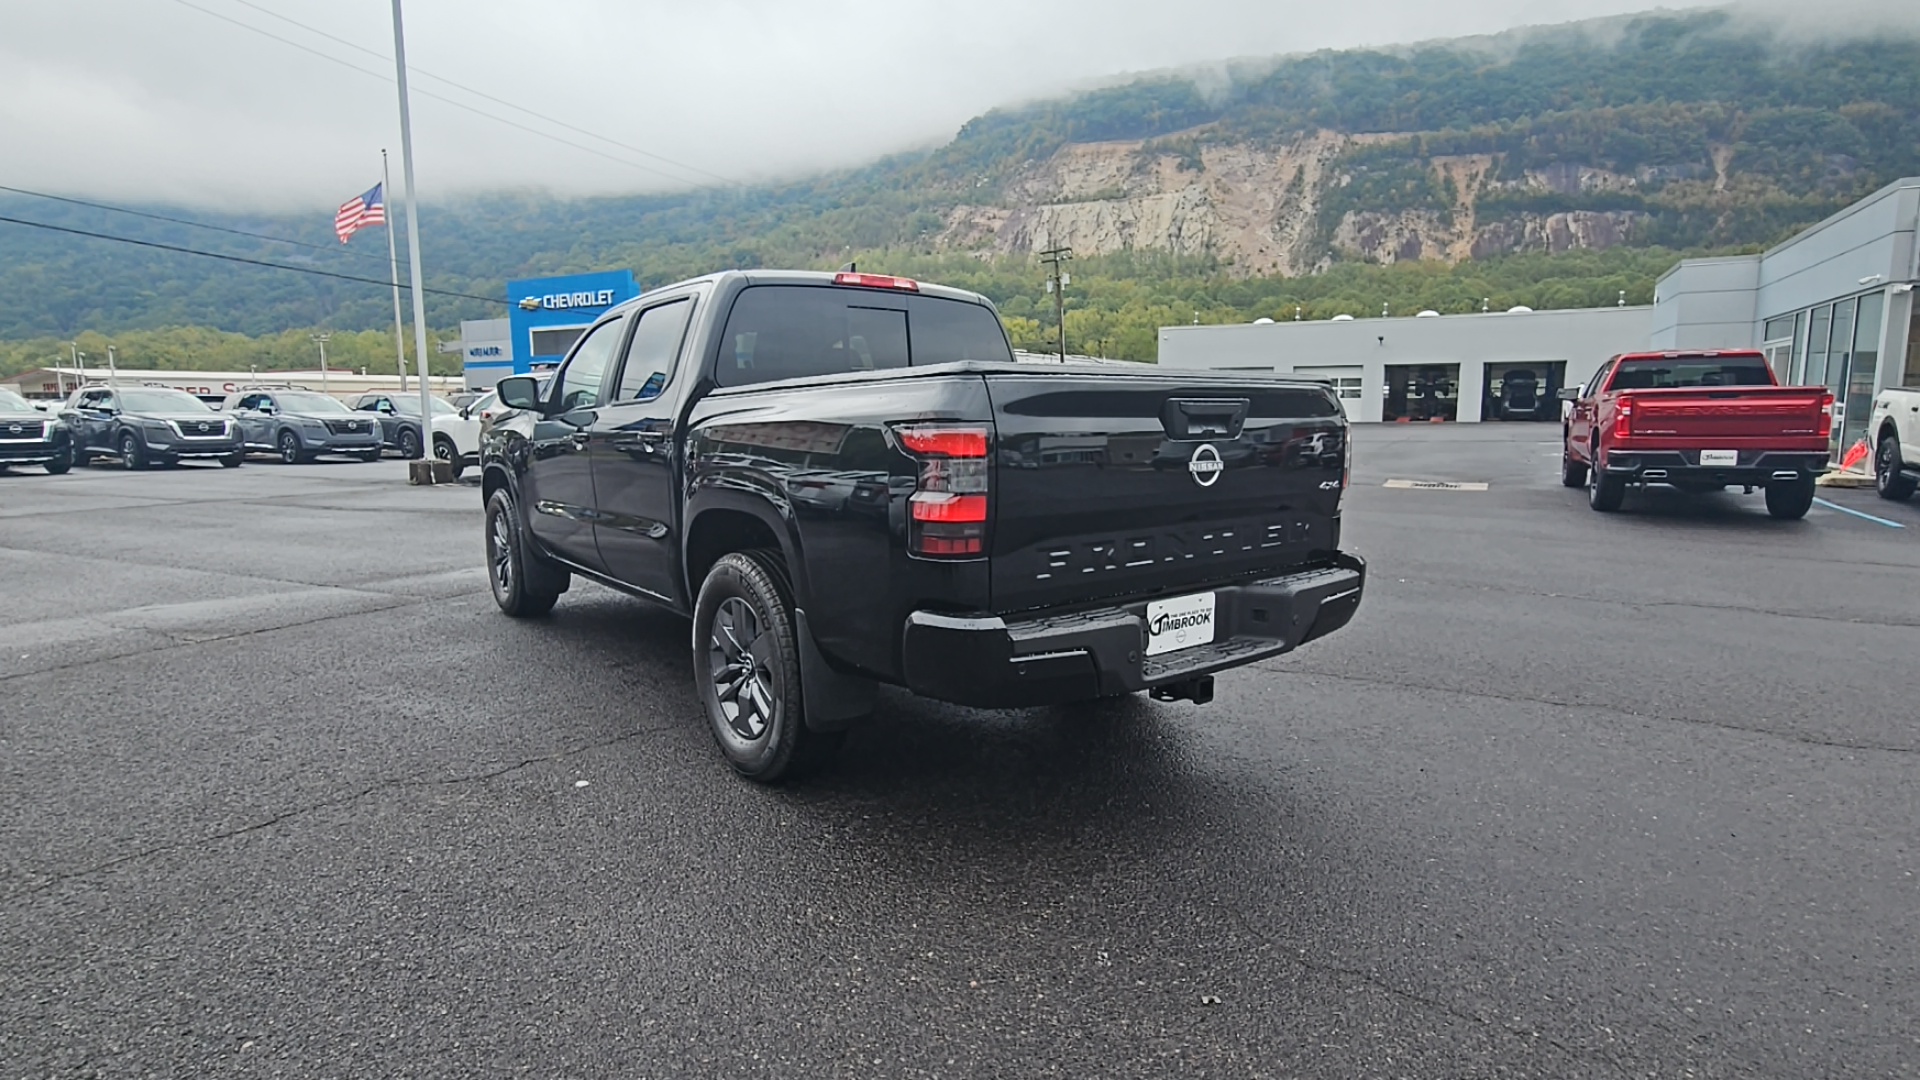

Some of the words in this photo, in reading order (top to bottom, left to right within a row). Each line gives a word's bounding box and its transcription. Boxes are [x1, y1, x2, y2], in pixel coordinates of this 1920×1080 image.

[543, 290, 614, 309] CHEVROLET
[1189, 461, 1224, 472] NISSAN
[1035, 521, 1311, 578] FRONTIER
